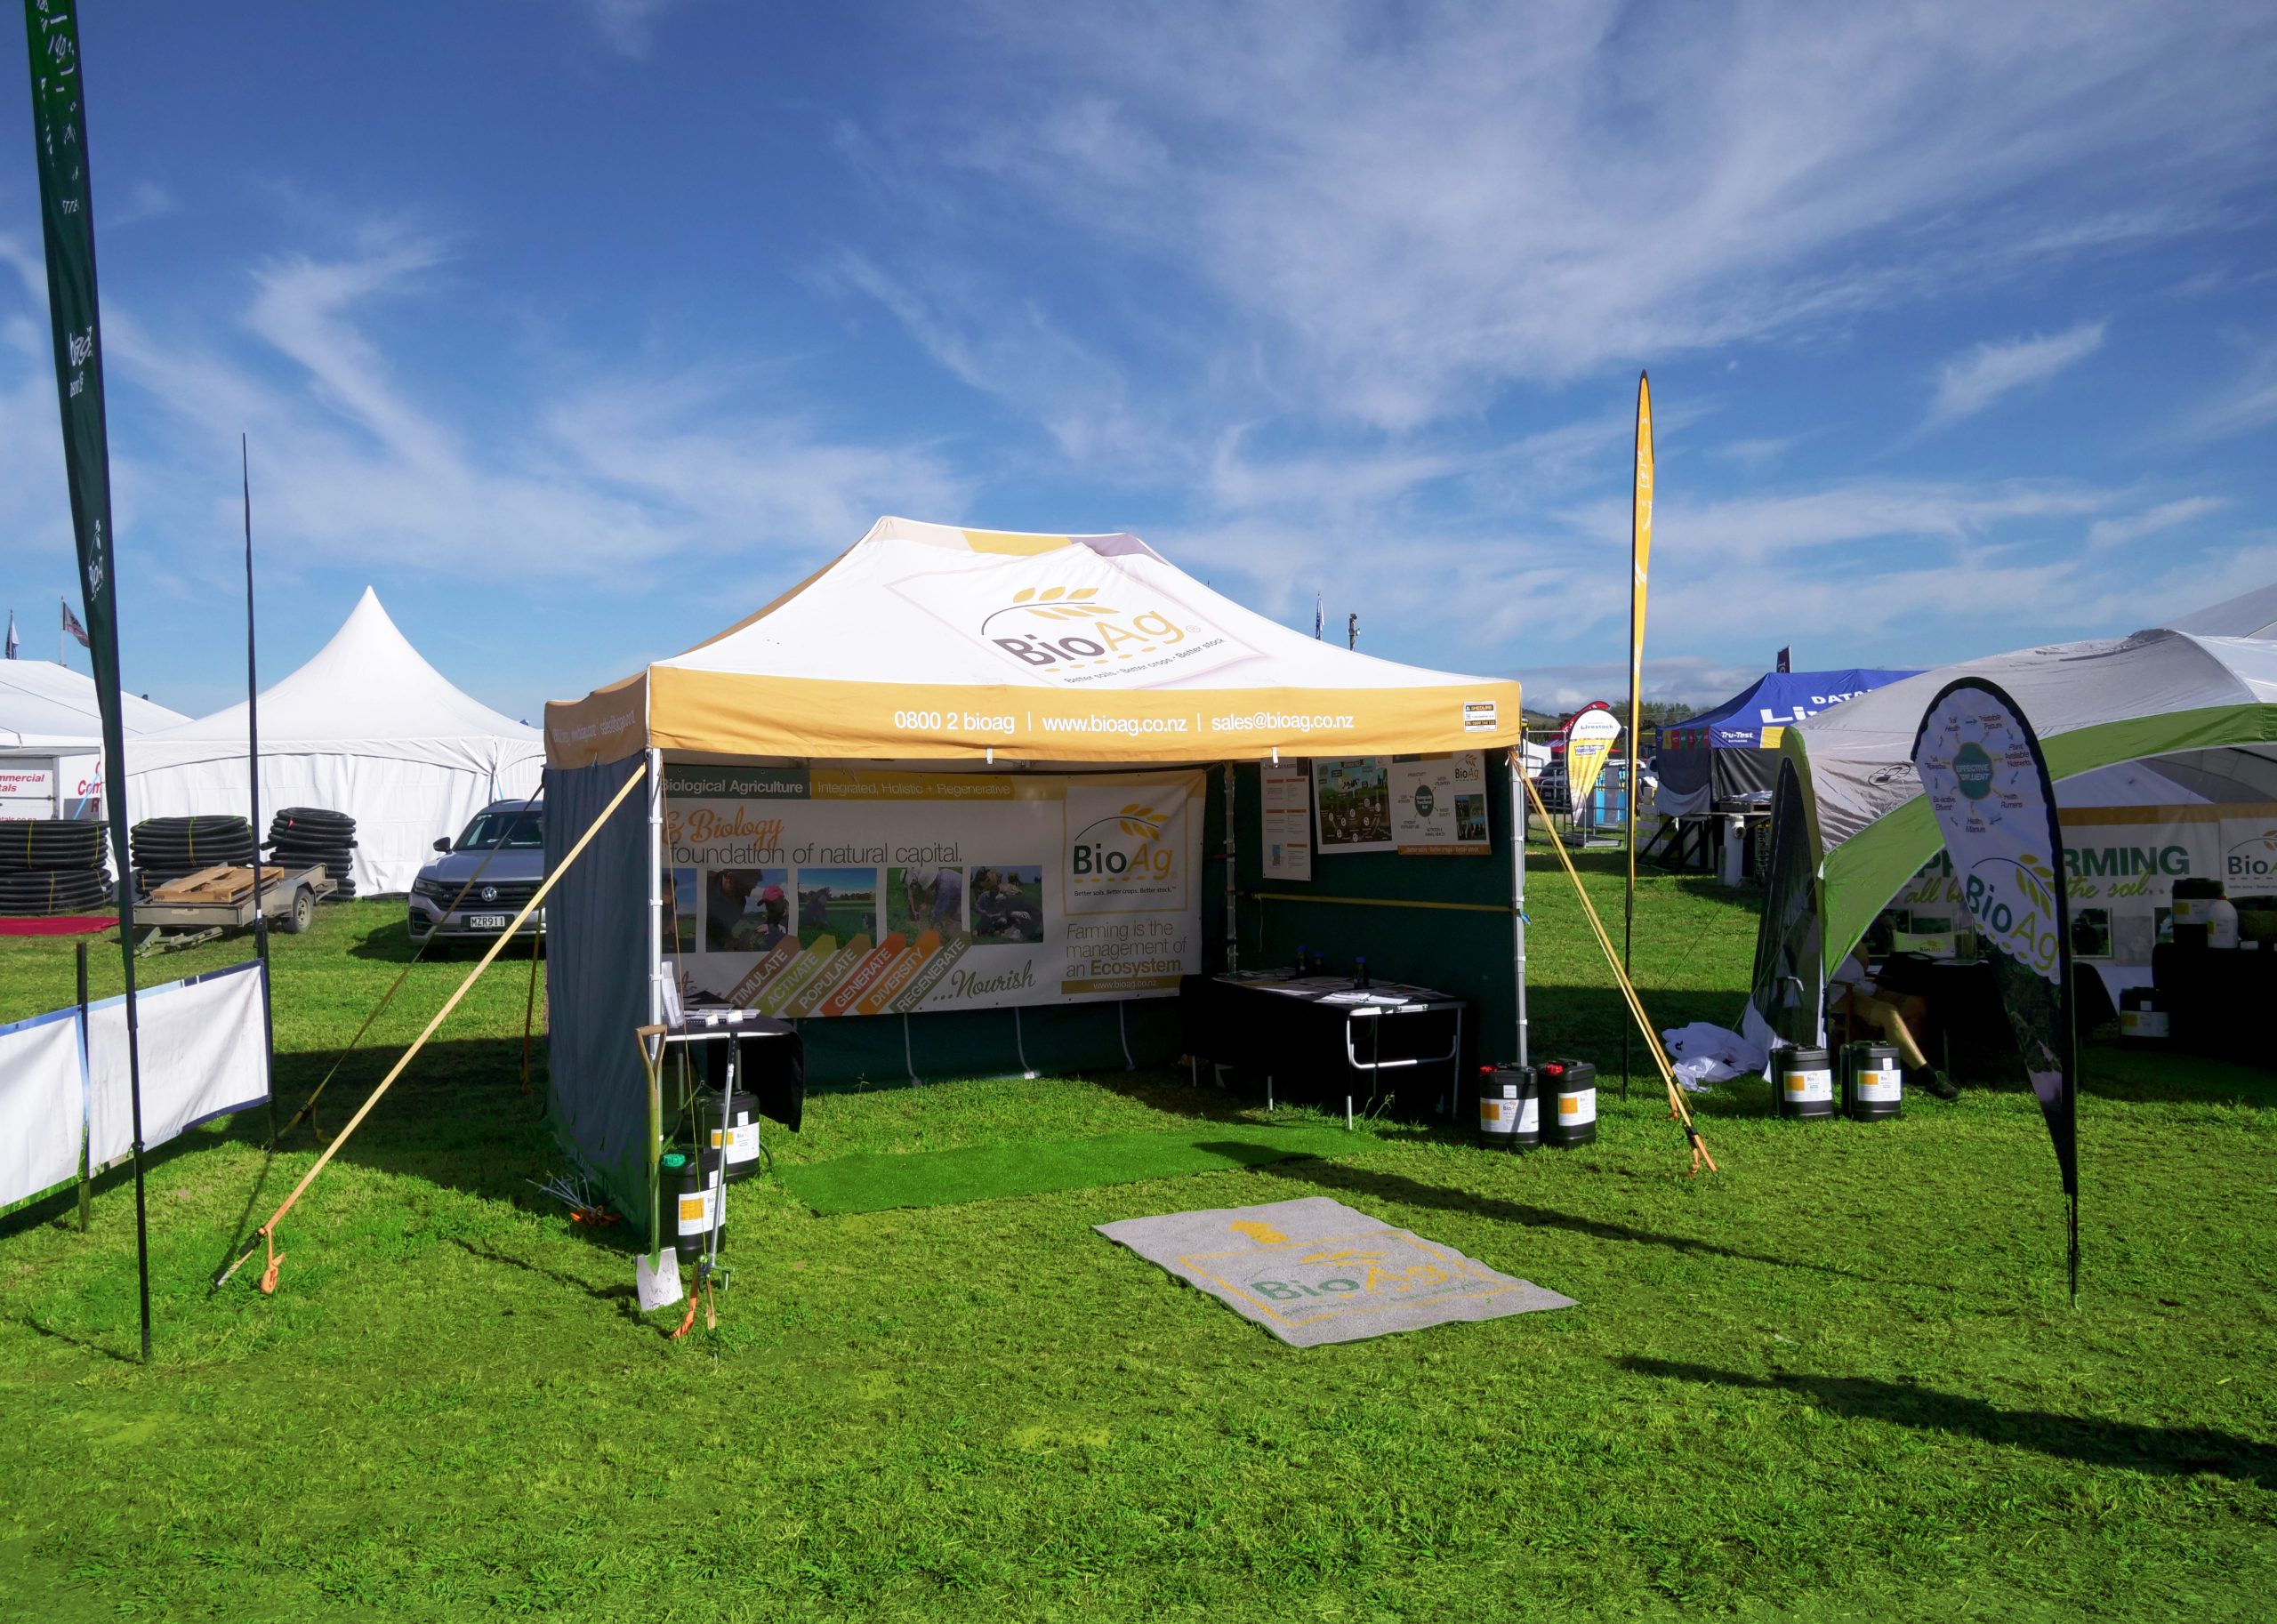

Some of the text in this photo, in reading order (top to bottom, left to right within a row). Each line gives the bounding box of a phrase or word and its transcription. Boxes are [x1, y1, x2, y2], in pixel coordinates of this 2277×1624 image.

[992, 611, 1185, 665] BioAg
[1811, 689, 1874, 704] DATA
[894, 711, 1014, 734] 0800 2 bioag
[1042, 715, 1187, 736] www.bioag.co.nz
[1211, 712, 1355, 732] sales@bioag.co.nz
[1721, 731, 1755, 739] Tru-Test
[0, 774, 45, 783] mmercial
[1455, 768, 1480, 781] BioAg
[0, 784, 17, 792] tals
[732, 779, 804, 796] Agriculture
[817, 782, 879, 797] Integrated,
[882, 783, 923, 795] Holistic
[937, 784, 1011, 798] Regenerative
[689, 806, 784, 851] Biology
[672, 842, 962, 868] foundation of natural capital.
[1074, 843, 1173, 880] BioAg
[2063, 846, 2190, 877] RMING
[2228, 855, 2277, 874] Bio
[471, 917, 503, 926] MZR911
[1066, 920, 1173, 942] Farming is the
[1966, 874, 2059, 970] BioAg
[1066, 937, 1187, 961] management of
[732, 948, 789, 1006] TIMULATE
[799, 948, 858, 1010] POPULATE
[834, 947, 892, 1009] GENERATE
[869, 947, 925, 1008] DIVERSITY
[896, 937, 967, 1013] REGENERATE
[1066, 958, 1183, 977] an Ecosystem.
[768, 952, 820, 1009] ACTIVATE
[1093, 979, 1156, 990] www.bioag.co.nz
[1251, 1266, 1447, 1300] BioAg
